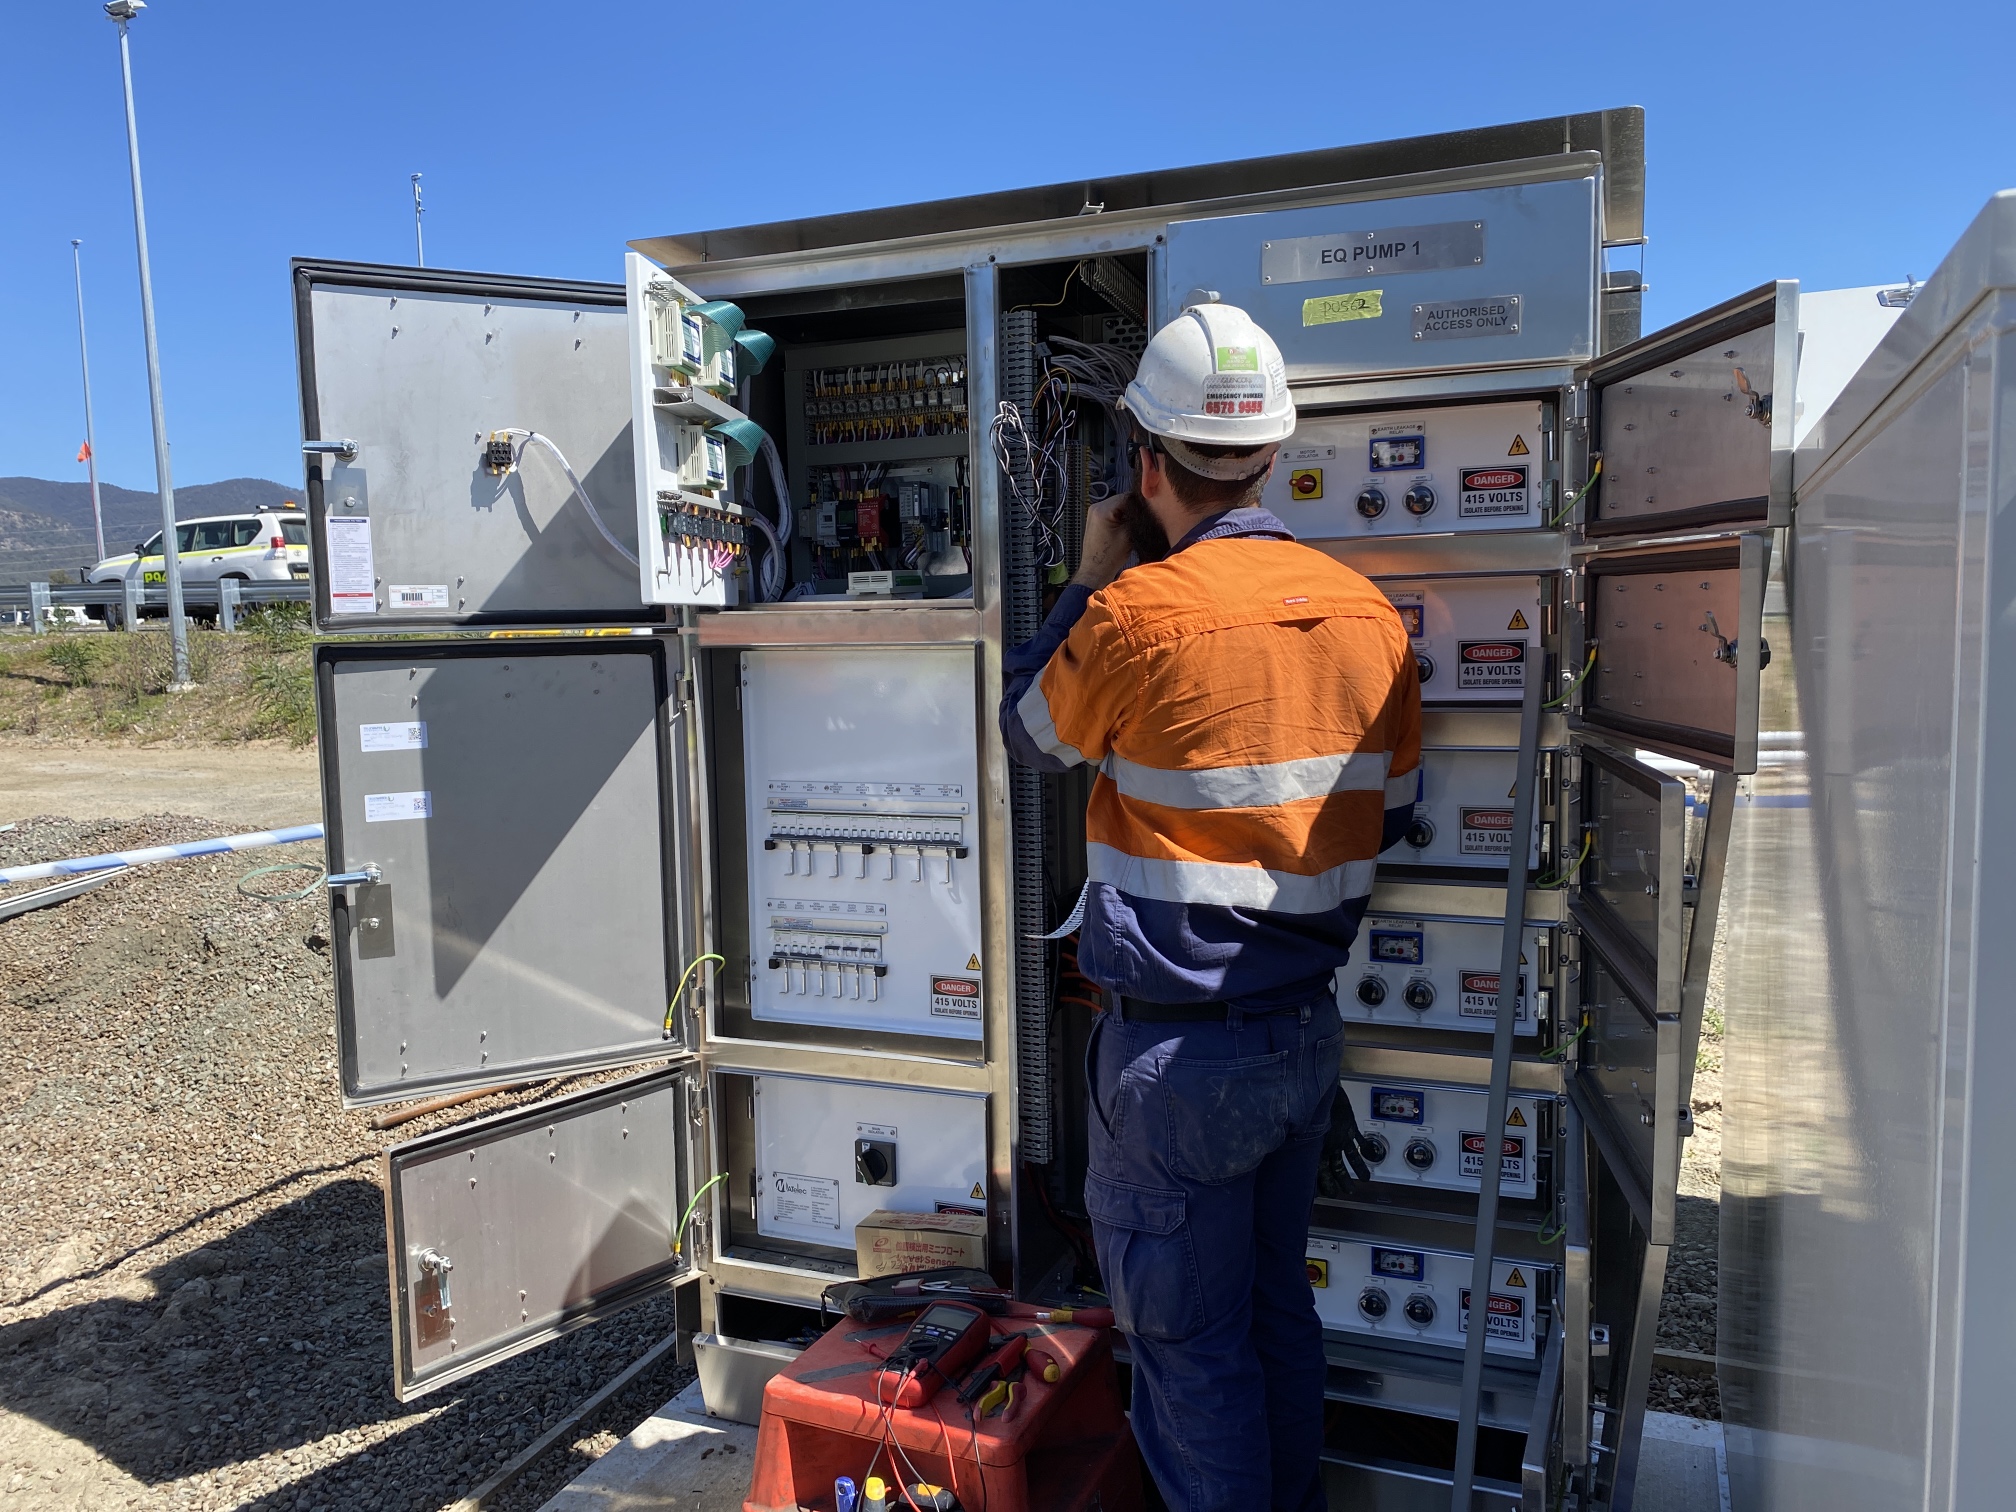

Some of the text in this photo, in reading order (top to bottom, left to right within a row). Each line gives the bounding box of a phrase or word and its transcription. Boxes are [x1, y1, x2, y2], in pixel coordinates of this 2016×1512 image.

[1321, 240, 1420, 265] EQ PUMP 1
[1427, 304, 1505, 320] AUTHORISED
[1423, 315, 1508, 332] ACCESS ONLY
[1206, 392, 1241, 400] EMERGENCY
[1205, 400, 1263, 414] 6578 9555
[1473, 474, 1515, 485] DANGER
[1464, 491, 1523, 504] 415 VOLTS
[1464, 504, 1524, 514] ISOLATE BEFORE OPENING
[1472, 648, 1513, 658] DANGER
[1463, 665, 1521, 676] 415 VOLTS
[1465, 832, 1485, 843] 415
[941, 982, 971, 993] DANGER
[1473, 979, 1500, 989] DANG
[934, 996, 977, 1009] 415 VOLTS
[1464, 995, 1484, 1006] 415
[1463, 1007, 1483, 1015] ISOLATE
[1464, 1155, 1483, 1166] 415
[924, 1255, 957, 1267] Sensor
